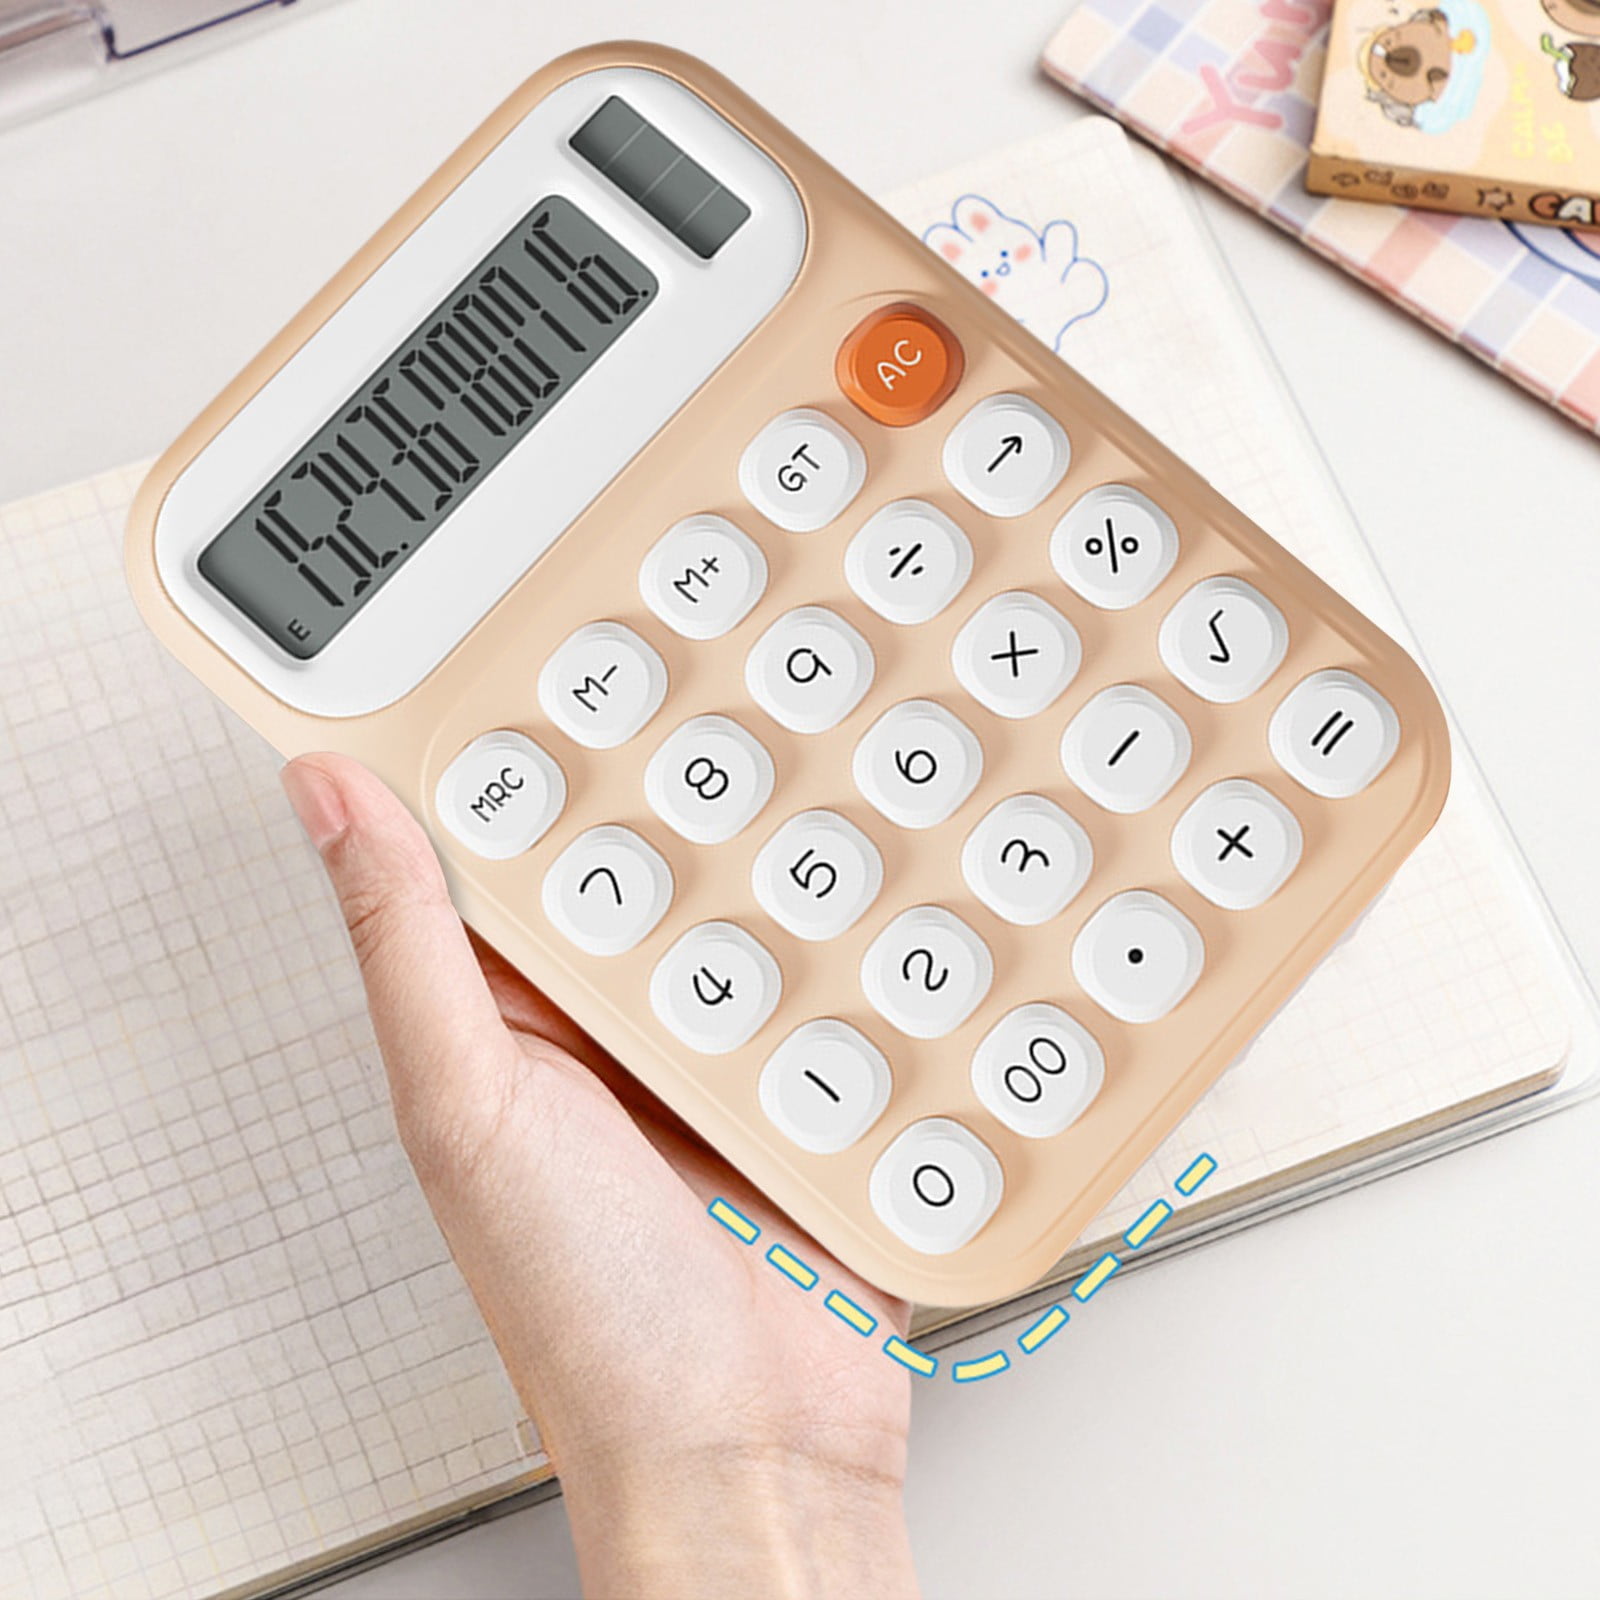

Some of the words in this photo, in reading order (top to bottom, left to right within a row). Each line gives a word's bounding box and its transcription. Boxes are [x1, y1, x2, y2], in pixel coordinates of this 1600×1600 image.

[1527, 191, 1600, 226] CA
[876, 340, 922, 390] AC
[777, 443, 821, 492] GT
[1085, 518, 1139, 574] %
[673, 556, 720, 603] M+
[286, 617, 311, 642] E
[786, 648, 832, 684] 9
[1311, 710, 1354, 756] =
[684, 757, 729, 800] 8
[895, 749, 937, 784] 6
[470, 767, 524, 822] MRC
[1001, 839, 1050, 873] 3
[1216, 824, 1254, 862] +
[579, 867, 622, 905] 7
[789, 849, 837, 899] 5
[693, 966, 734, 1006] 4
[902, 949, 949, 991] 2
[803, 1069, 841, 1103] 1
[1004, 1037, 1067, 1103] 00
[912, 1164, 955, 1207] 0
